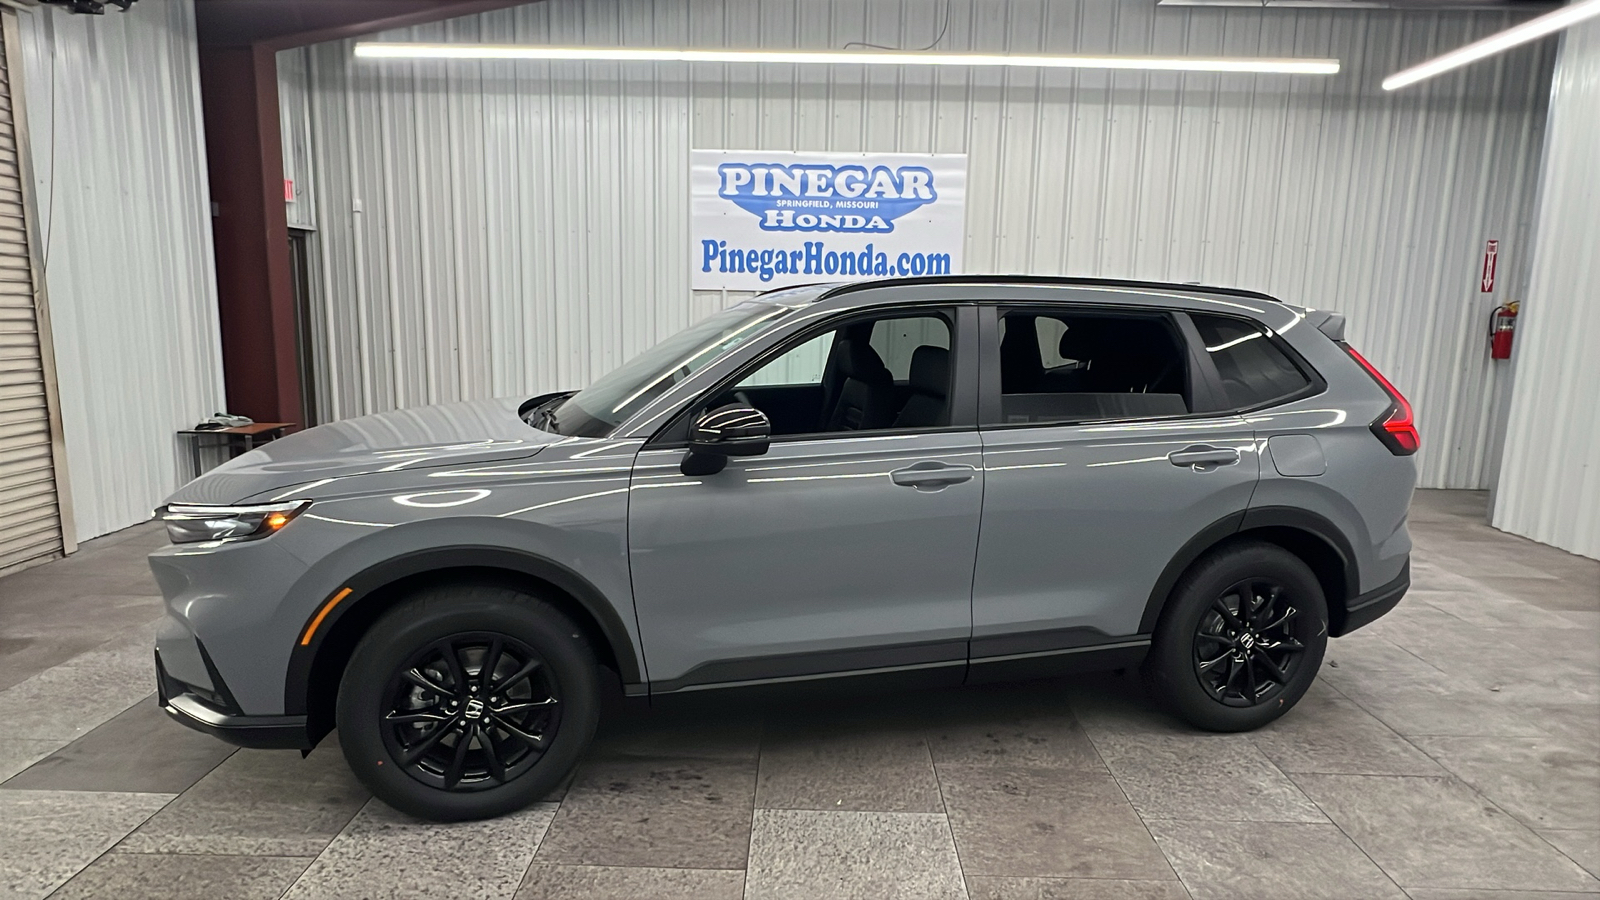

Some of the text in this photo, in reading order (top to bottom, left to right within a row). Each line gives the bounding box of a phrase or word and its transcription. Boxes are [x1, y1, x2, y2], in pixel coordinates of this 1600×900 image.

[722, 167, 934, 199] PINEGAR
[776, 199, 879, 209] SPRINGFIELD, MISSOURI
[701, 239, 951, 282] PinegarHonda.com
